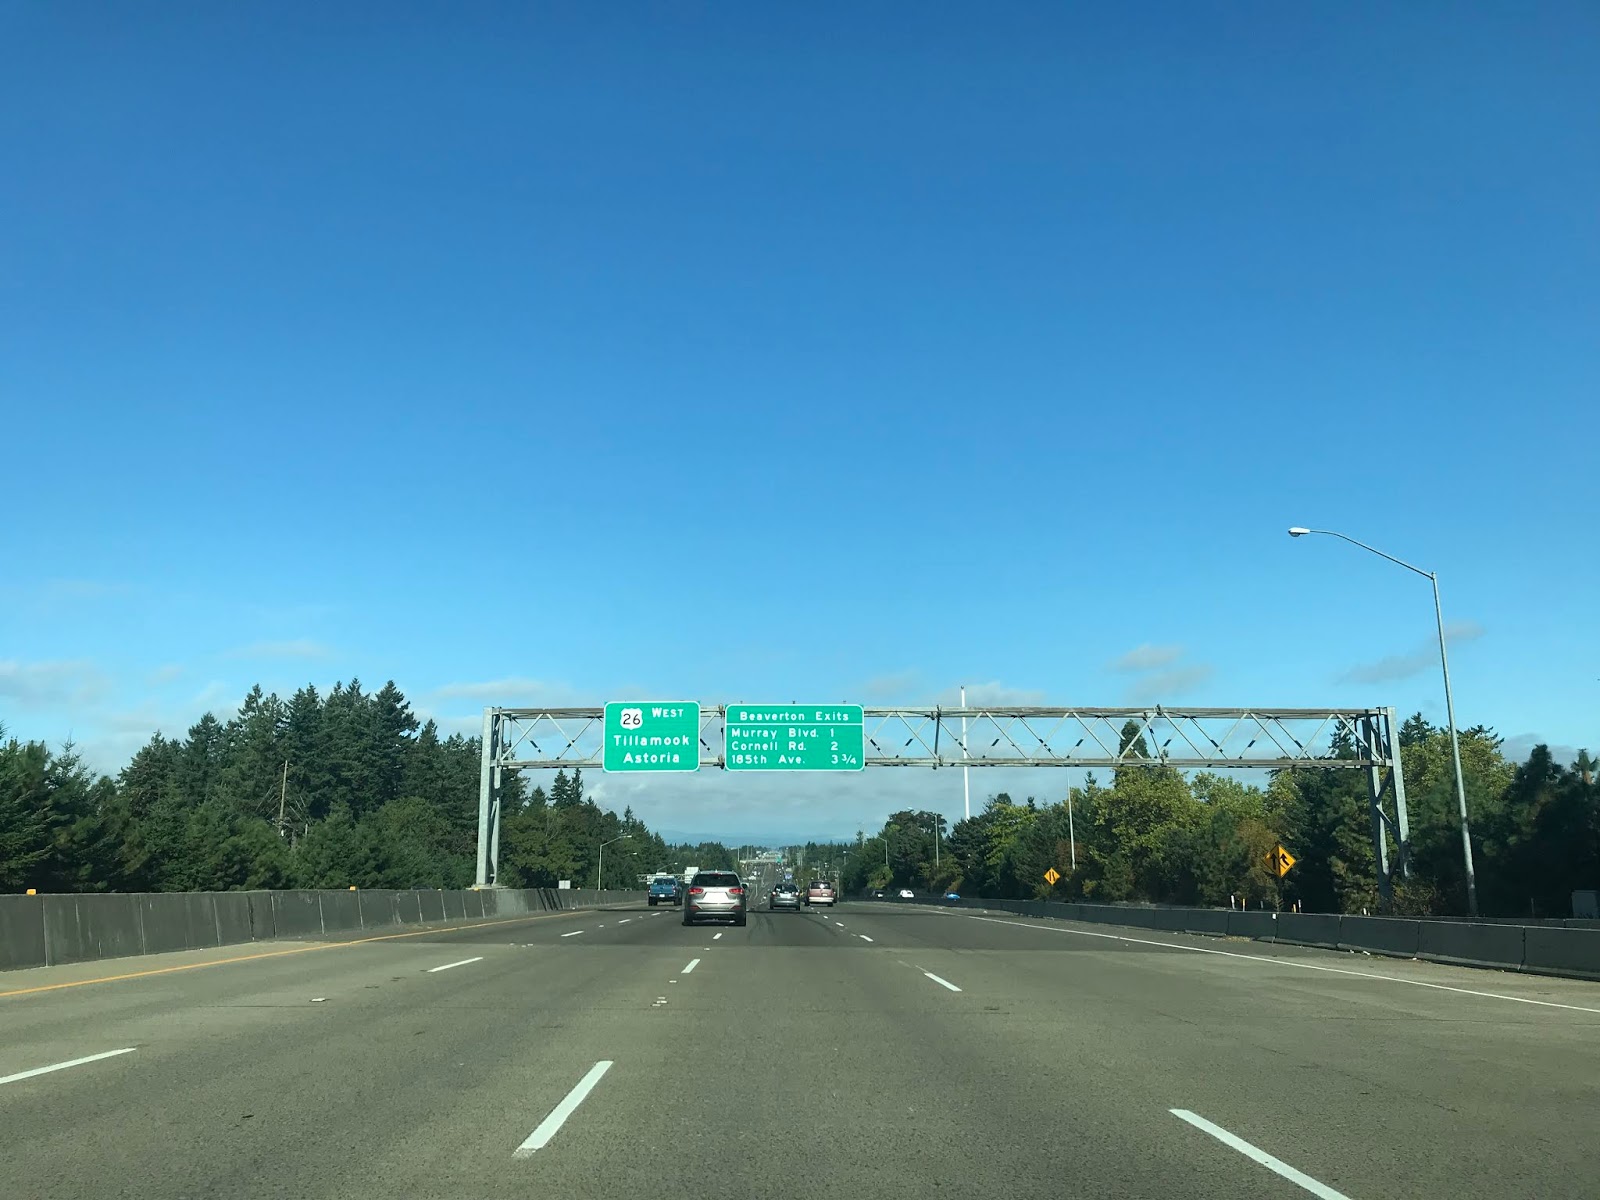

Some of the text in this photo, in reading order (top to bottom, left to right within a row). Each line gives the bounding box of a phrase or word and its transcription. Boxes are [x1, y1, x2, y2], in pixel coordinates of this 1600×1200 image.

[622, 707, 684, 725] 26 WEST
[740, 712, 849, 721] Beaverton Exits
[731, 728, 834, 739] Murray Blvd. 1
[614, 735, 690, 746] Tillamook
[731, 741, 838, 751] Cornell Rd. 2
[623, 752, 679, 763] Astoria
[731, 755, 767, 764] 185th
[778, 755, 805, 764] Ave.
